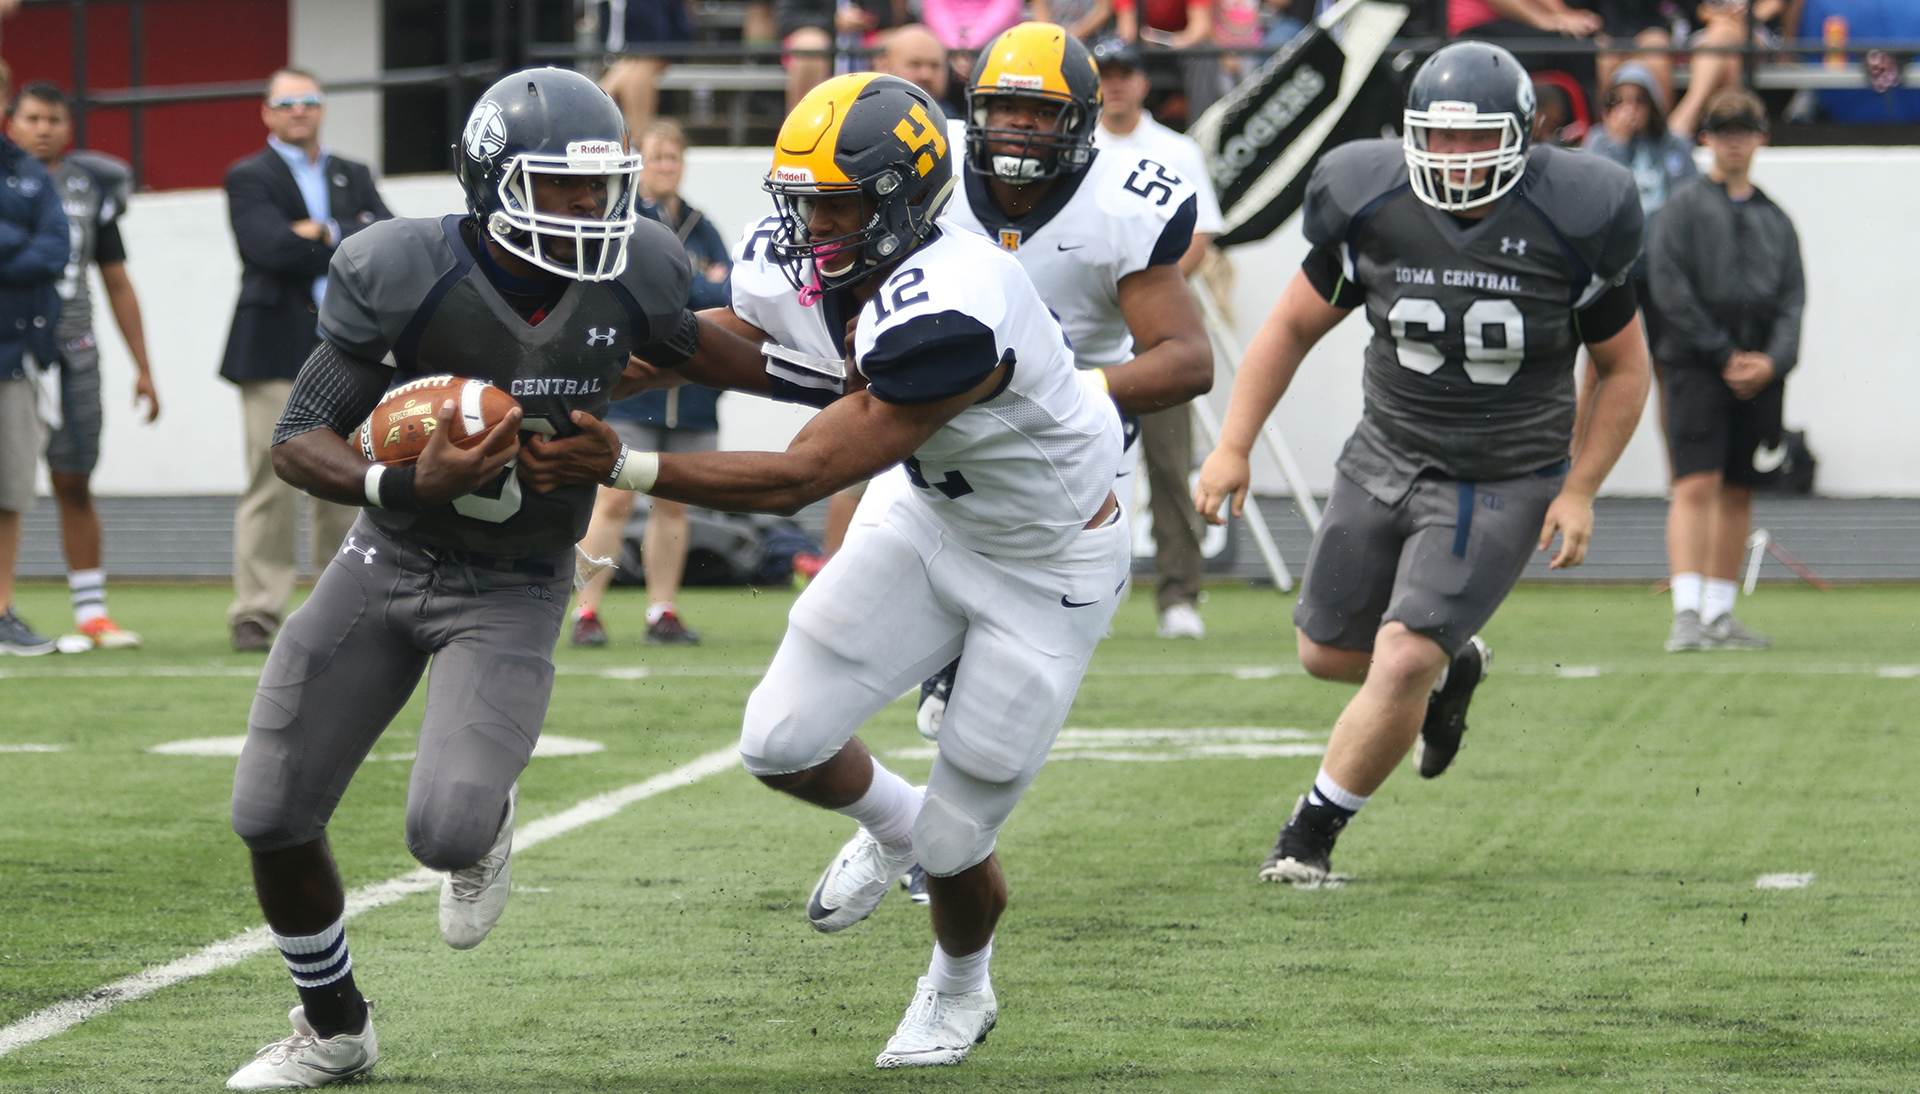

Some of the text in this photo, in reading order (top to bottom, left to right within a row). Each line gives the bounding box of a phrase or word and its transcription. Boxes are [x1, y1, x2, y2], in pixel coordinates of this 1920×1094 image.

[1213, 63, 1327, 190] ROGERS
[580, 145, 610, 154] Riddell
[776, 170, 807, 182] Riddell
[1123, 159, 1182, 206] 52
[1002, 232, 1019, 251] H
[1395, 267, 1522, 292] IOWA CENTRAL
[869, 268, 929, 326] 12
[1387, 297, 1525, 385] 69
[511, 378, 601, 396] CENTRAL
[610, 470, 619, 479] NO
